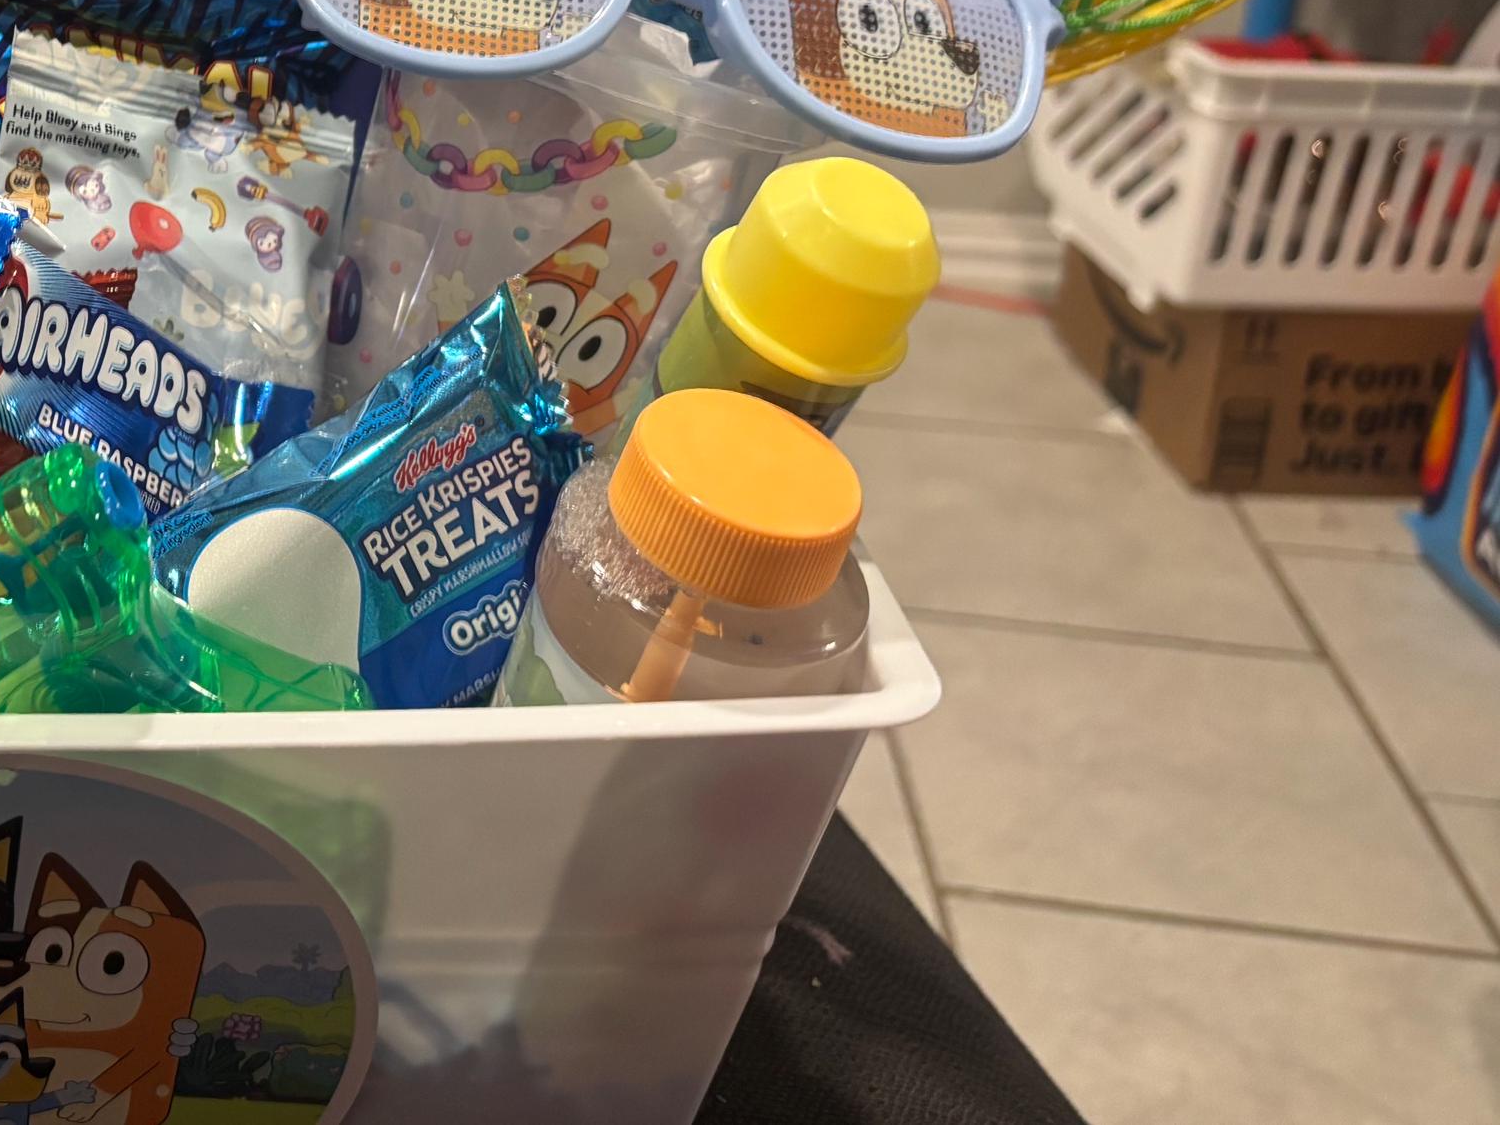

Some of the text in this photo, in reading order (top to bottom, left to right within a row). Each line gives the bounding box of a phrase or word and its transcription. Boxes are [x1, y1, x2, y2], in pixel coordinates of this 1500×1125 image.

[5, 120, 31, 138] find
[33, 125, 52, 141] the
[55, 132, 110, 155] matching
[11, 103, 42, 125] Help
[45, 108, 79, 132] Bluey
[1305, 351, 1421, 393] From
[38, 403, 190, 508] BLUE RASPBER
[394, 423, 477, 493] Kellogg's
[363, 437, 532, 564] RICE KRISPIES
[380, 469, 540, 597] TREATS
[410, 542, 518, 619] CRISPY MARSHMALLOW
[450, 586, 524, 649] Origi
